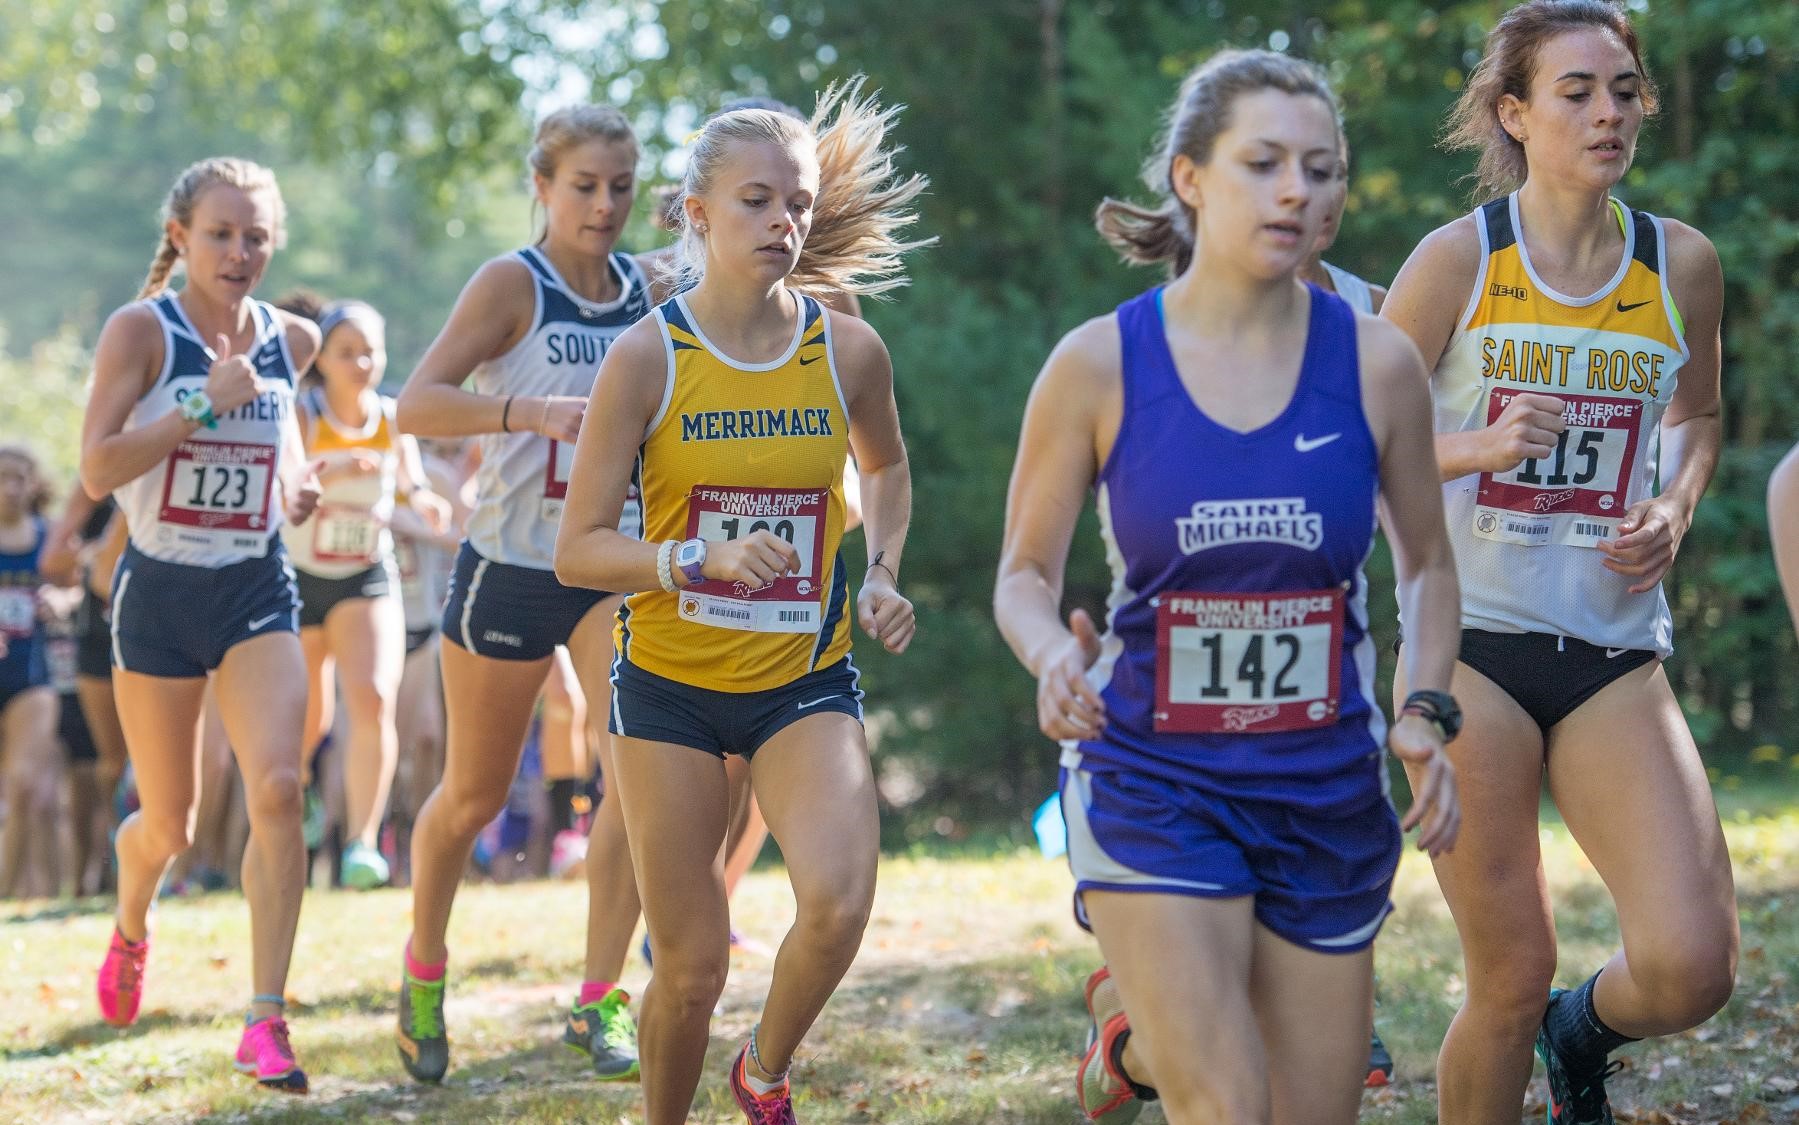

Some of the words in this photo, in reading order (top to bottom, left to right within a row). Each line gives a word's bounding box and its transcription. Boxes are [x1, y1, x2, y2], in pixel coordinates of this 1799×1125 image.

[1482, 337, 1575, 387] SAINT
[1586, 348, 1665, 397] ROSE
[1581, 402, 1633, 417] PIERCE
[681, 408, 833, 442] MERRIMACK
[1561, 412, 1611, 427] ERSITY
[188, 466, 249, 508] 123
[702, 490, 771, 505] FRANKLIN
[773, 493, 819, 505] PIERCE
[720, 502, 800, 516] UNIVERSITY
[1197, 502, 1301, 519] SAINT
[1183, 517, 1319, 551] MICHAELS
[1169, 598, 1264, 615] FRANKLIN
[1268, 596, 1333, 615] PIERCE
[1196, 612, 1306, 628] UNIVERSITY
[1201, 633, 1302, 699] 142
